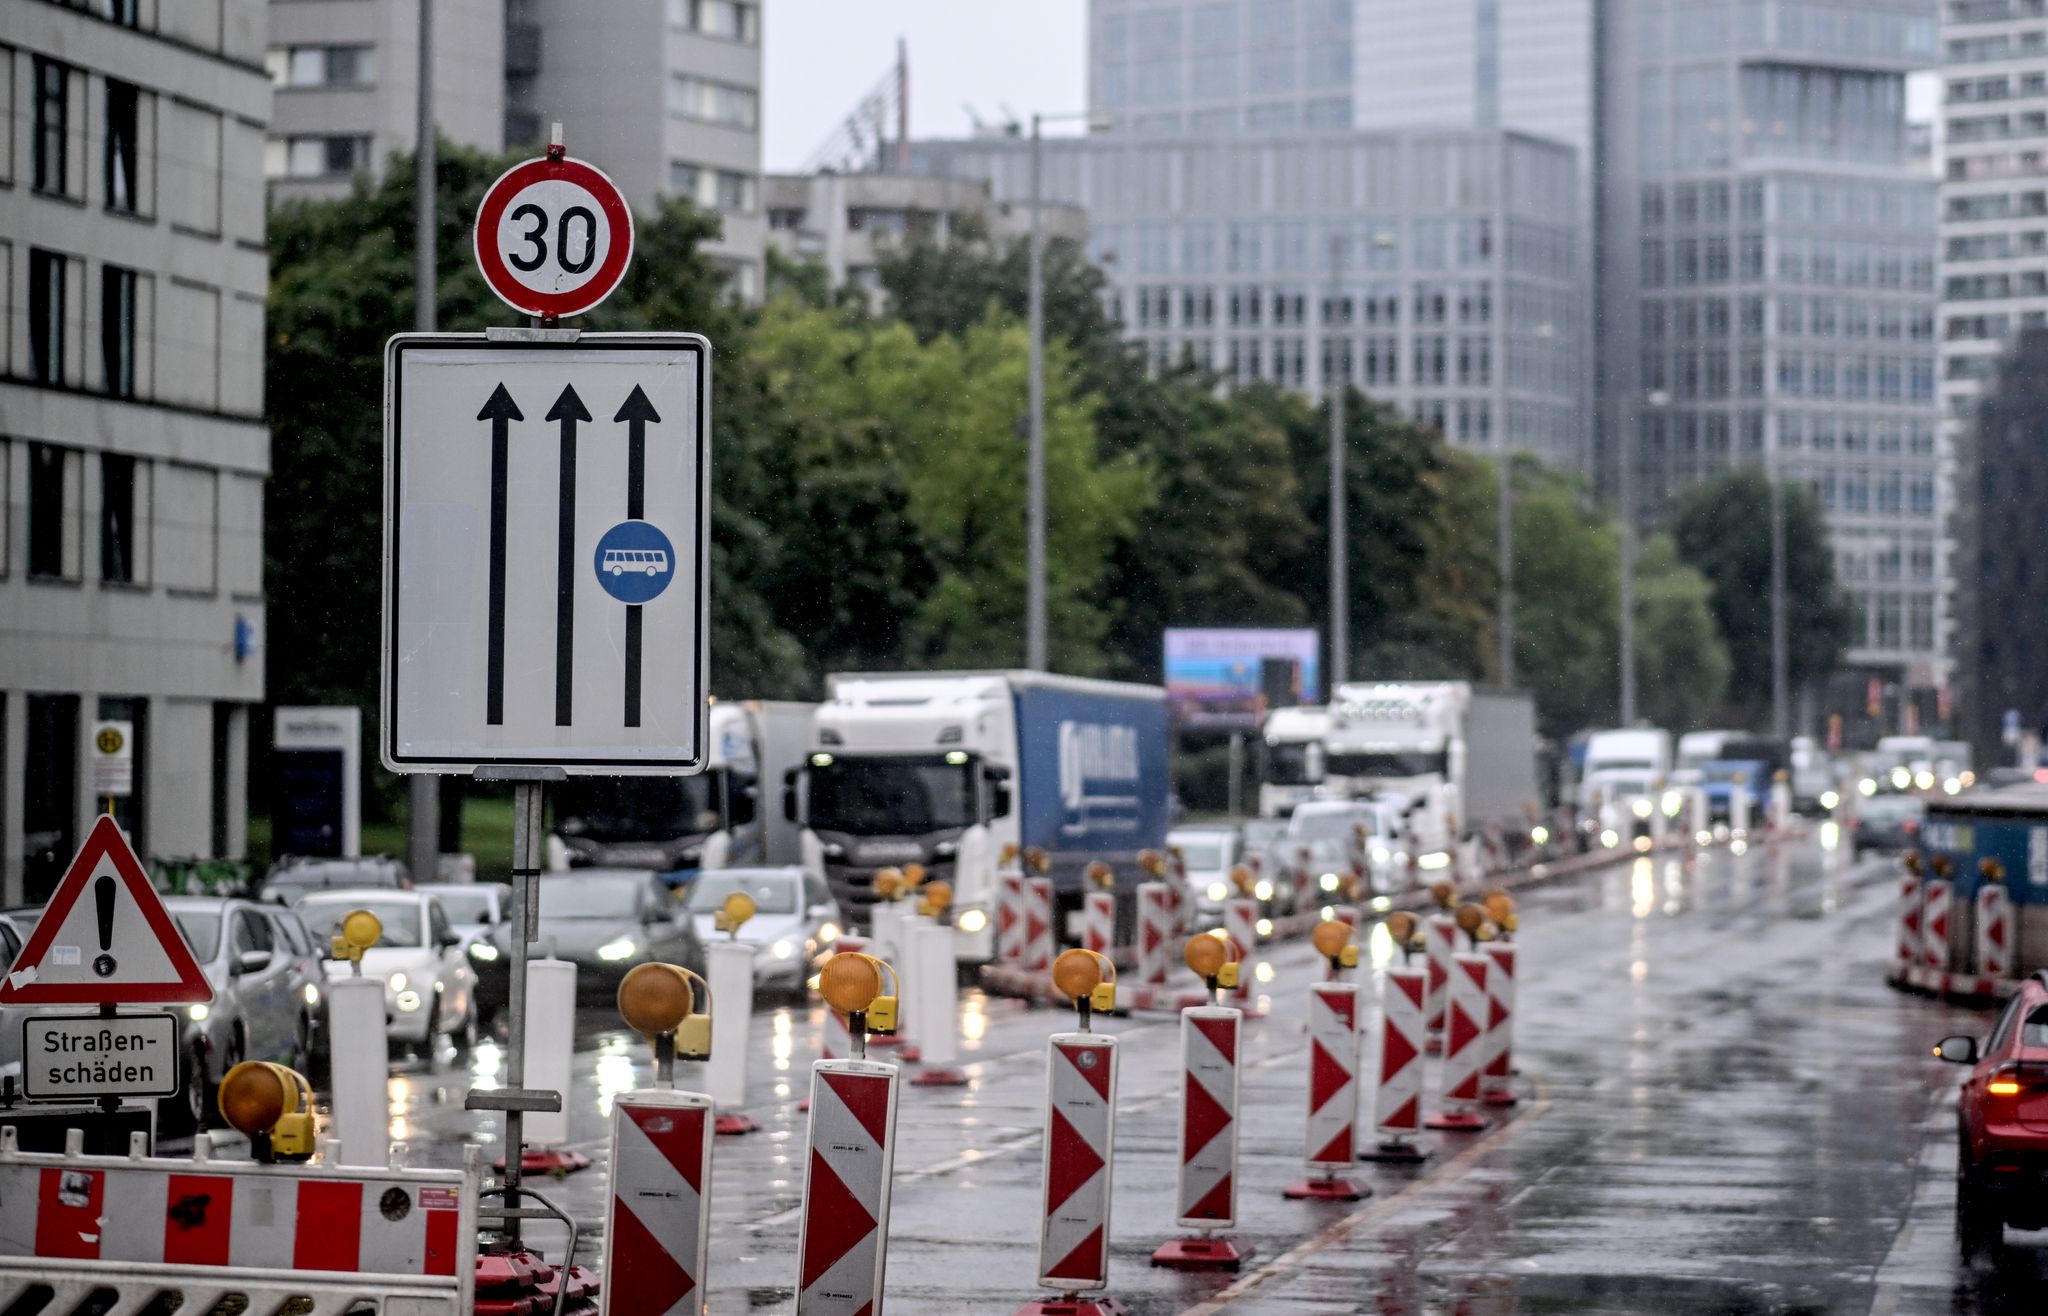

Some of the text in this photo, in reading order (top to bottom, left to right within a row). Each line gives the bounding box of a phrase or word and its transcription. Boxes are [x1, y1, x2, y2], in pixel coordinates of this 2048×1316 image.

[508, 204, 597, 274] 30
[44, 1029, 157, 1053] Straßen-
[48, 1060, 153, 1084] schäden
